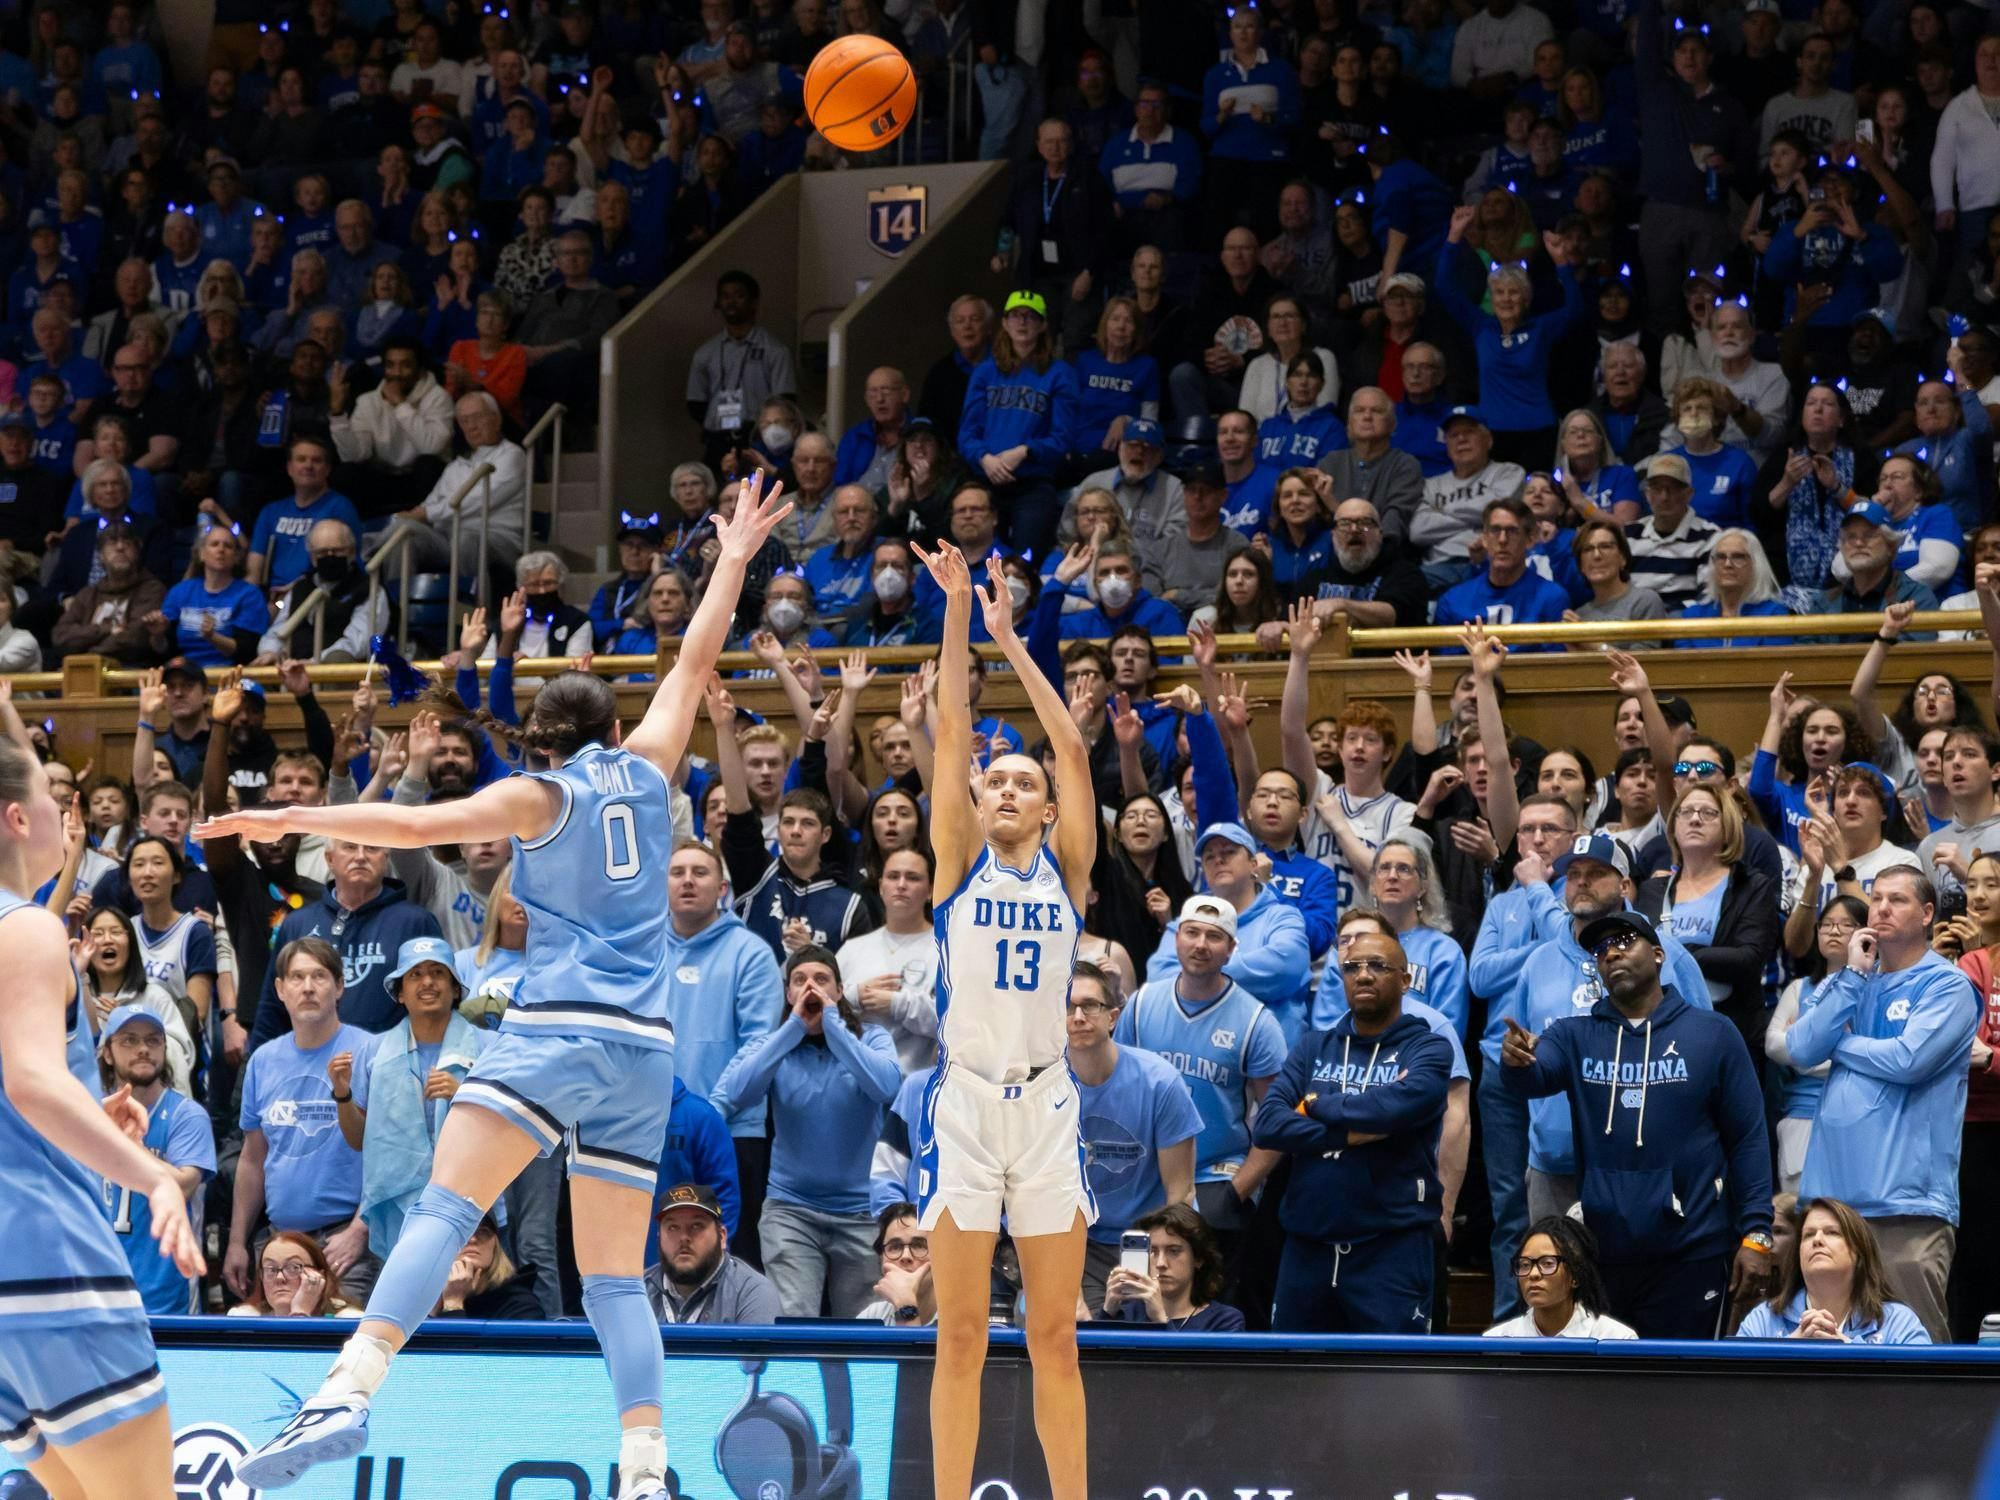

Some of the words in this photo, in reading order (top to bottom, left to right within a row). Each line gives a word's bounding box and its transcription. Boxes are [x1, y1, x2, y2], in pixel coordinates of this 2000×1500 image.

[878, 205, 918, 244] 14
[1089, 375, 1133, 393] DUKE
[986, 386, 1048, 415] DUKE
[31, 438, 62, 460] KE
[275, 517, 314, 536] DUK
[602, 804, 641, 881] 0
[453, 892, 486, 925] DU
[974, 897, 1063, 933] DUKE
[145, 960, 176, 982] KE
[994, 938, 1041, 992] 13
[1581, 1056, 1689, 1084] CAROLINA
[1002, 1086, 1022, 1100] D
[919, 1168, 930, 1197] D
